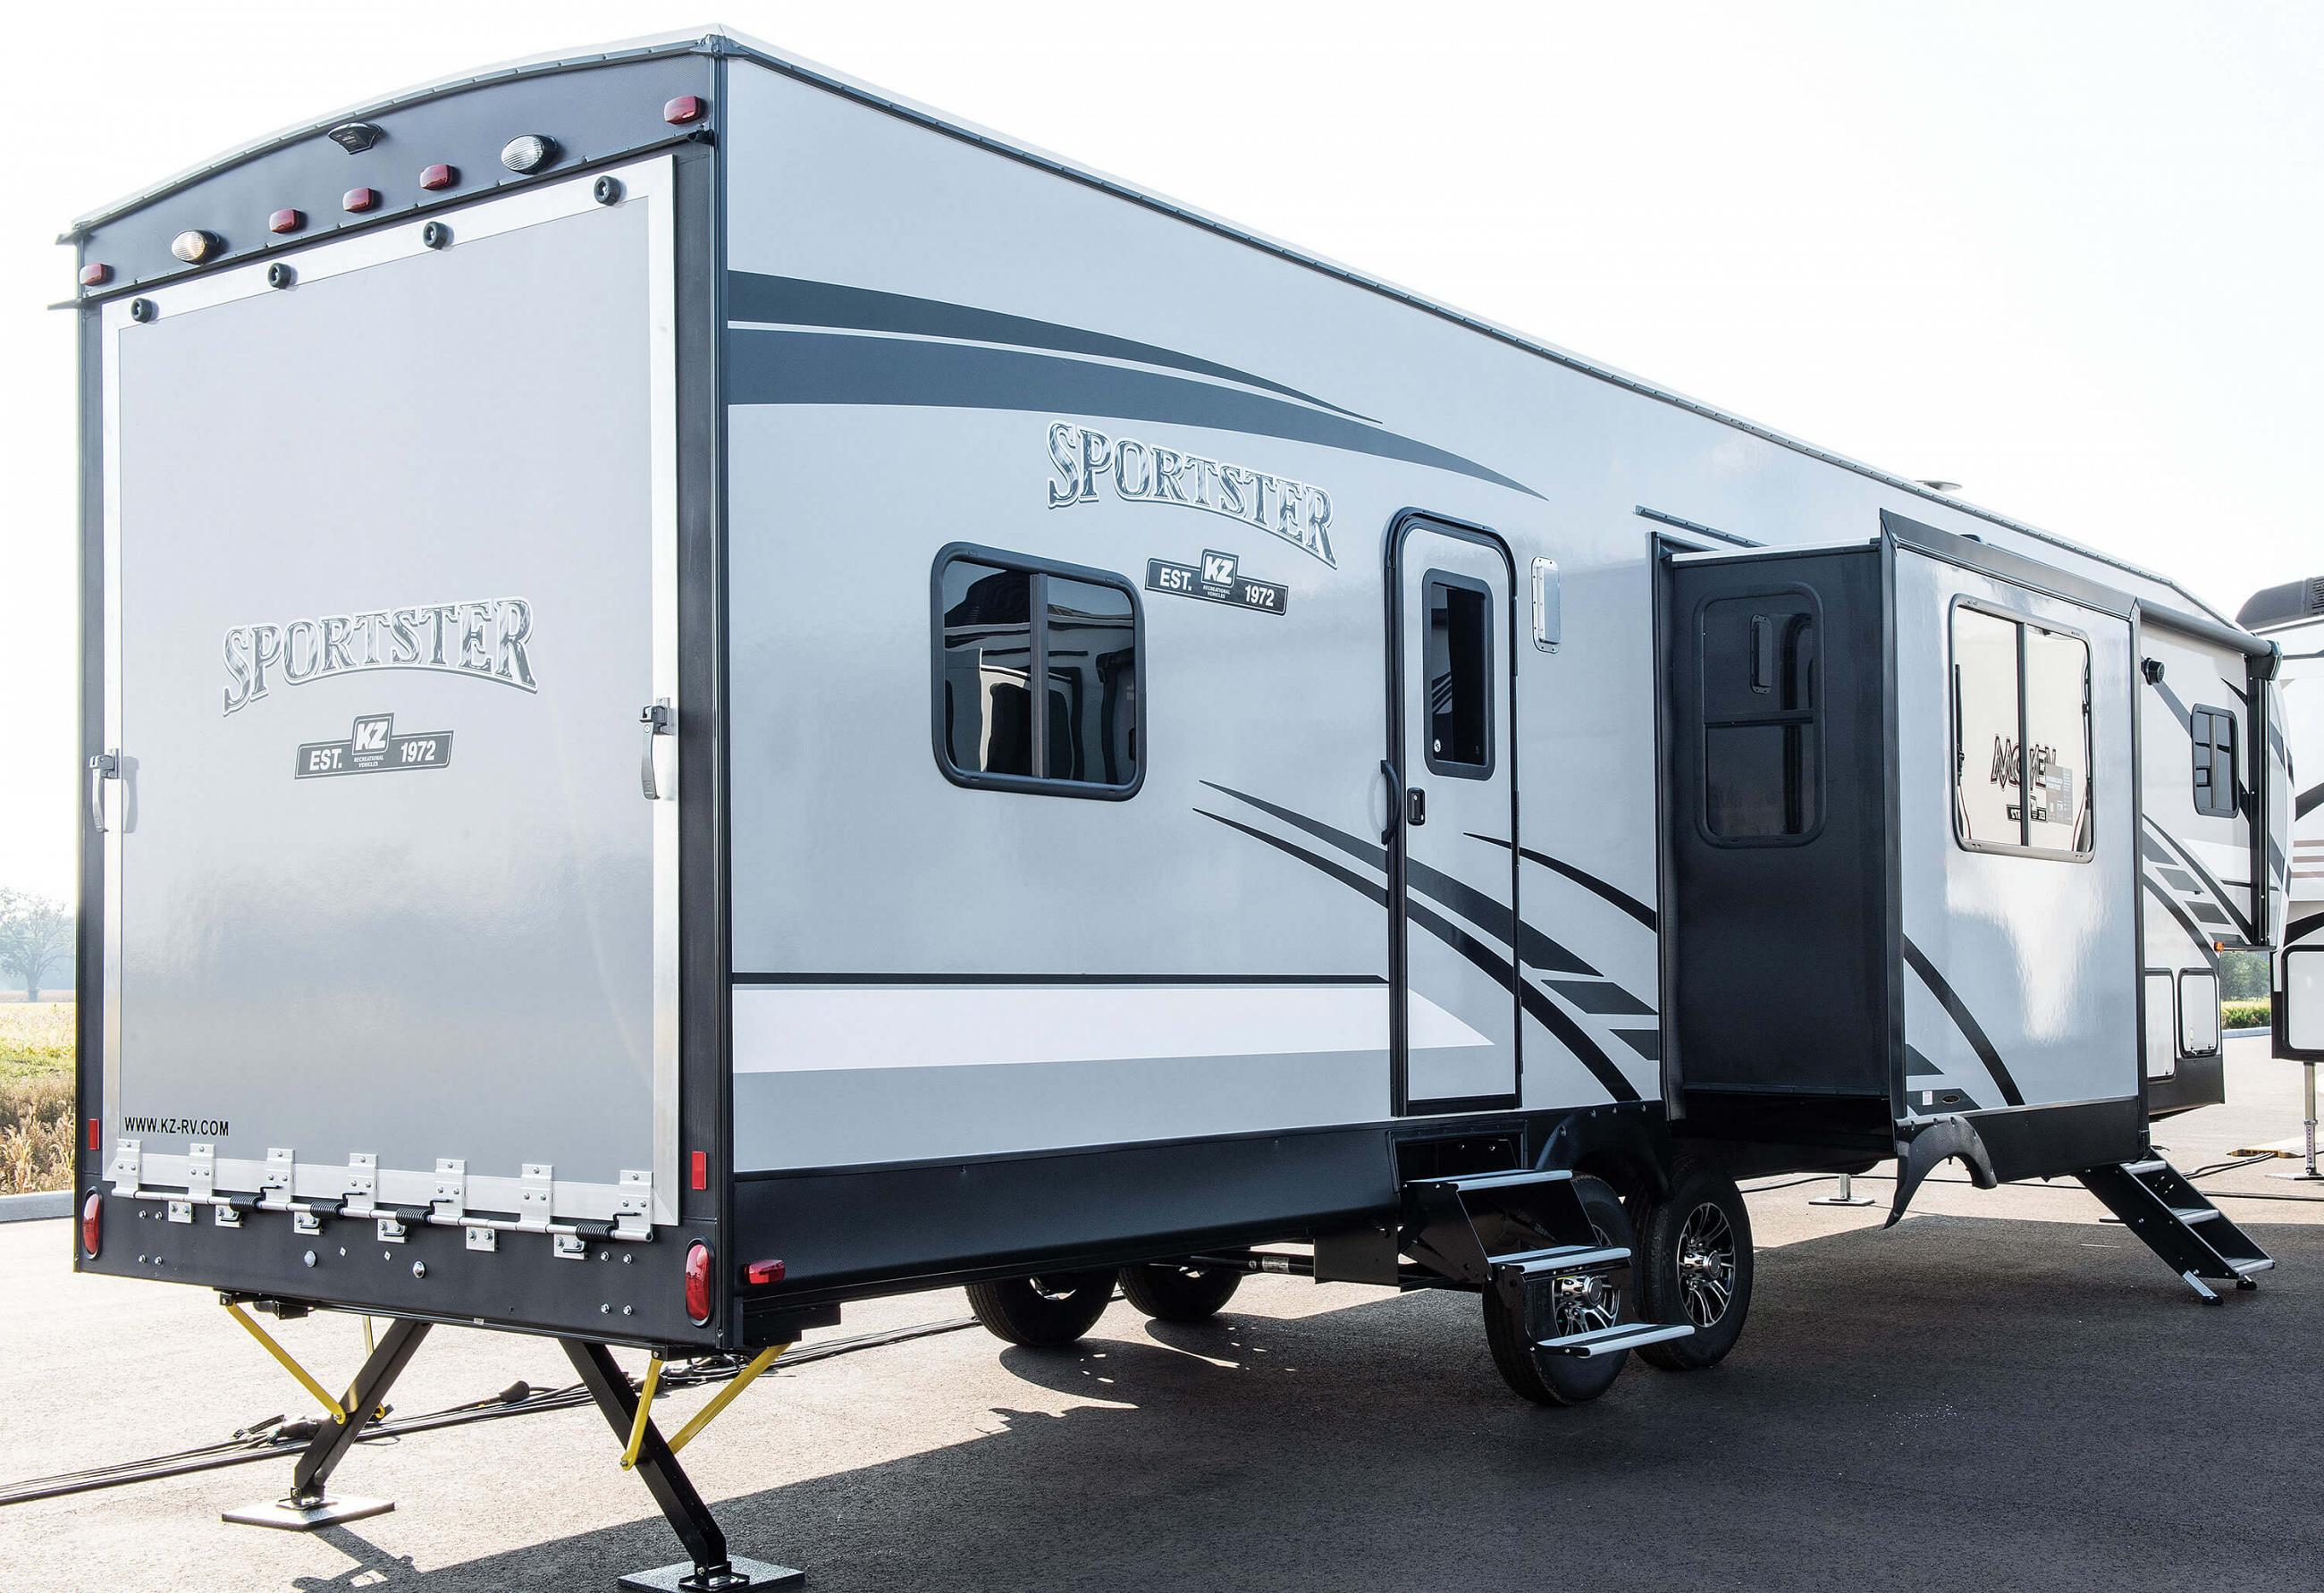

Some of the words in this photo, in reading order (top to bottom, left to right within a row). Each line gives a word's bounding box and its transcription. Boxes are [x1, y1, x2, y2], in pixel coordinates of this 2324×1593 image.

[1047, 420, 1337, 569] SPORTSTER
[1204, 555, 1234, 585] KZ
[1160, 568, 1192, 591] EST.
[1244, 585, 1275, 607] 1972
[223, 596, 537, 716] SPORTSTER
[355, 721, 389, 751] KZ
[309, 748, 343, 771] EST.
[400, 740, 436, 763] 1972
[124, 1117, 230, 1136] WWW.KZ-RV.COM
